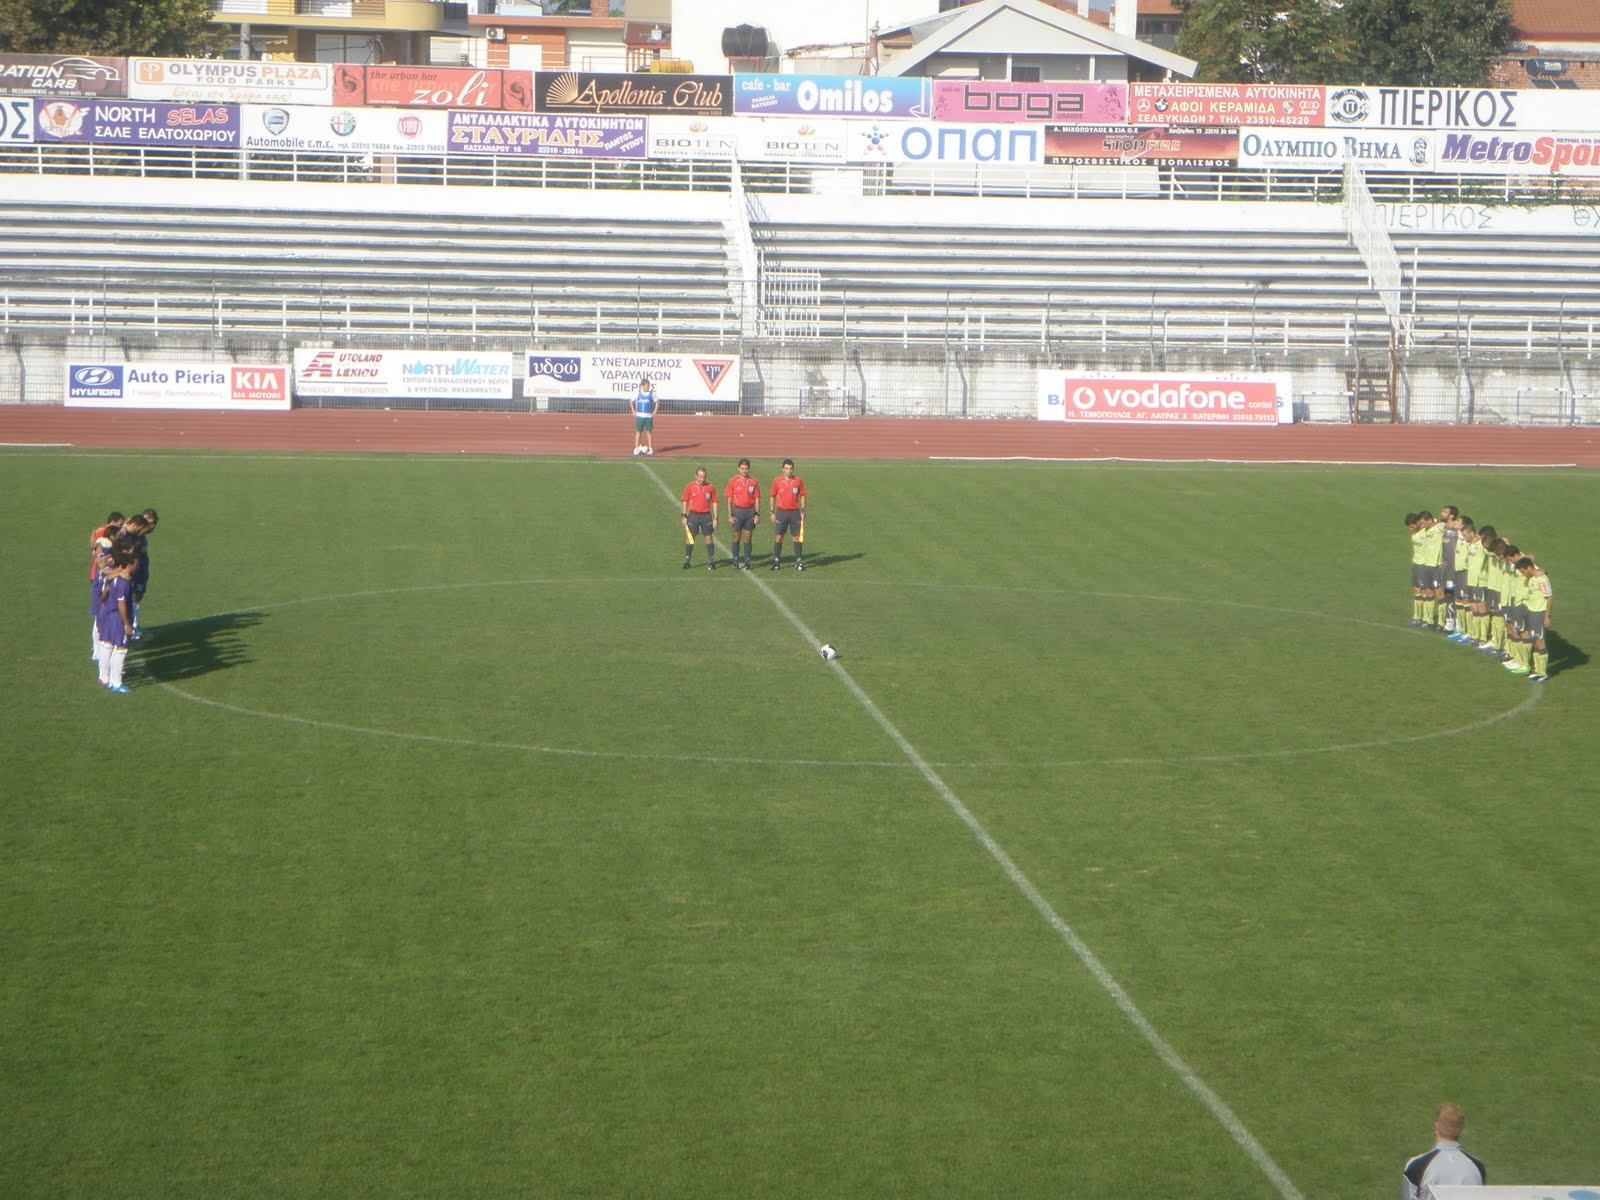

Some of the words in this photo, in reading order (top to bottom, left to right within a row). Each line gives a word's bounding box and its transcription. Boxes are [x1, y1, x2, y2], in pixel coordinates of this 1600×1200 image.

[169, 63, 257, 78] OLYMPUS
[261, 67, 322, 80] PLAZA
[370, 70, 387, 80] the
[389, 72, 418, 81] urban
[421, 71, 438, 81] bar
[32, 78, 78, 89] CARS
[196, 76, 236, 84] FOOD
[246, 78, 296, 87] PARKS
[773, 78, 792, 92] bar
[409, 71, 489, 107] zoli
[576, 79, 667, 113] Apollonia
[673, 80, 723, 107] Club
[796, 79, 893, 113] Omilos
[1134, 86, 1240, 99] ΜΕΤΑΧΕΙΡΙΣΜΕΝΑ
[1245, 87, 1321, 100] ΑΥΤΟΚΙΝΗΤΑ
[964, 84, 1084, 119] boga
[1170, 101, 1203, 113] ΑΦΟΙ
[1210, 101, 1276, 114] ΚΕΡΑΜΙΔΑ
[1379, 88, 1518, 127] ΠΙΕΡΙΚΟΣ
[95, 106, 156, 123] NORTH
[167, 107, 229, 126] SELAS
[453, 113, 550, 128] ΑΝΤΑΛΛΑΚΤΙΚΑ
[554, 116, 644, 130] ΑΥΤΟΚΙΝΗΤΩΝ
[1137, 114, 1205, 124] ΣΕΛΕΥΚΙΔΩΝ
[1208, 115, 1214, 123] 7
[1220, 116, 1243, 125] ΤΗΛ.
[1246, 116, 1310, 126] 23510-45220
[95, 126, 132, 139] ΣΑΛΕ
[138, 127, 236, 143] ΕΛΑΤΟΧΩΡΙΟΥ
[451, 125, 604, 148] ΣΤΑΥΡΙΔΗΣ
[246, 135, 305, 149] Automobile
[513, 145, 522, 153] 16
[656, 138, 735, 150] BIOTEN
[766, 141, 840, 151] BIOTEN
[1375, 203, 1492, 230] ΠΙΕΡΙΚΟΣ
[532, 357, 578, 379] υδρώ
[592, 357, 683, 369] ΣΥΝΕΤΑΙΡΙΣΜΟΣ
[128, 369, 169, 385] Auto
[175, 370, 225, 385] Pieria
[236, 370, 279, 390] KIA
[600, 370, 671, 381] ΥΔΡΑΥΛΙΚΩΝ
[71, 388, 121, 397] HYUNDAI
[232, 391, 246, 399] KIA
[1102, 383, 1245, 409] vodafone
[1248, 400, 1273, 409] contel
